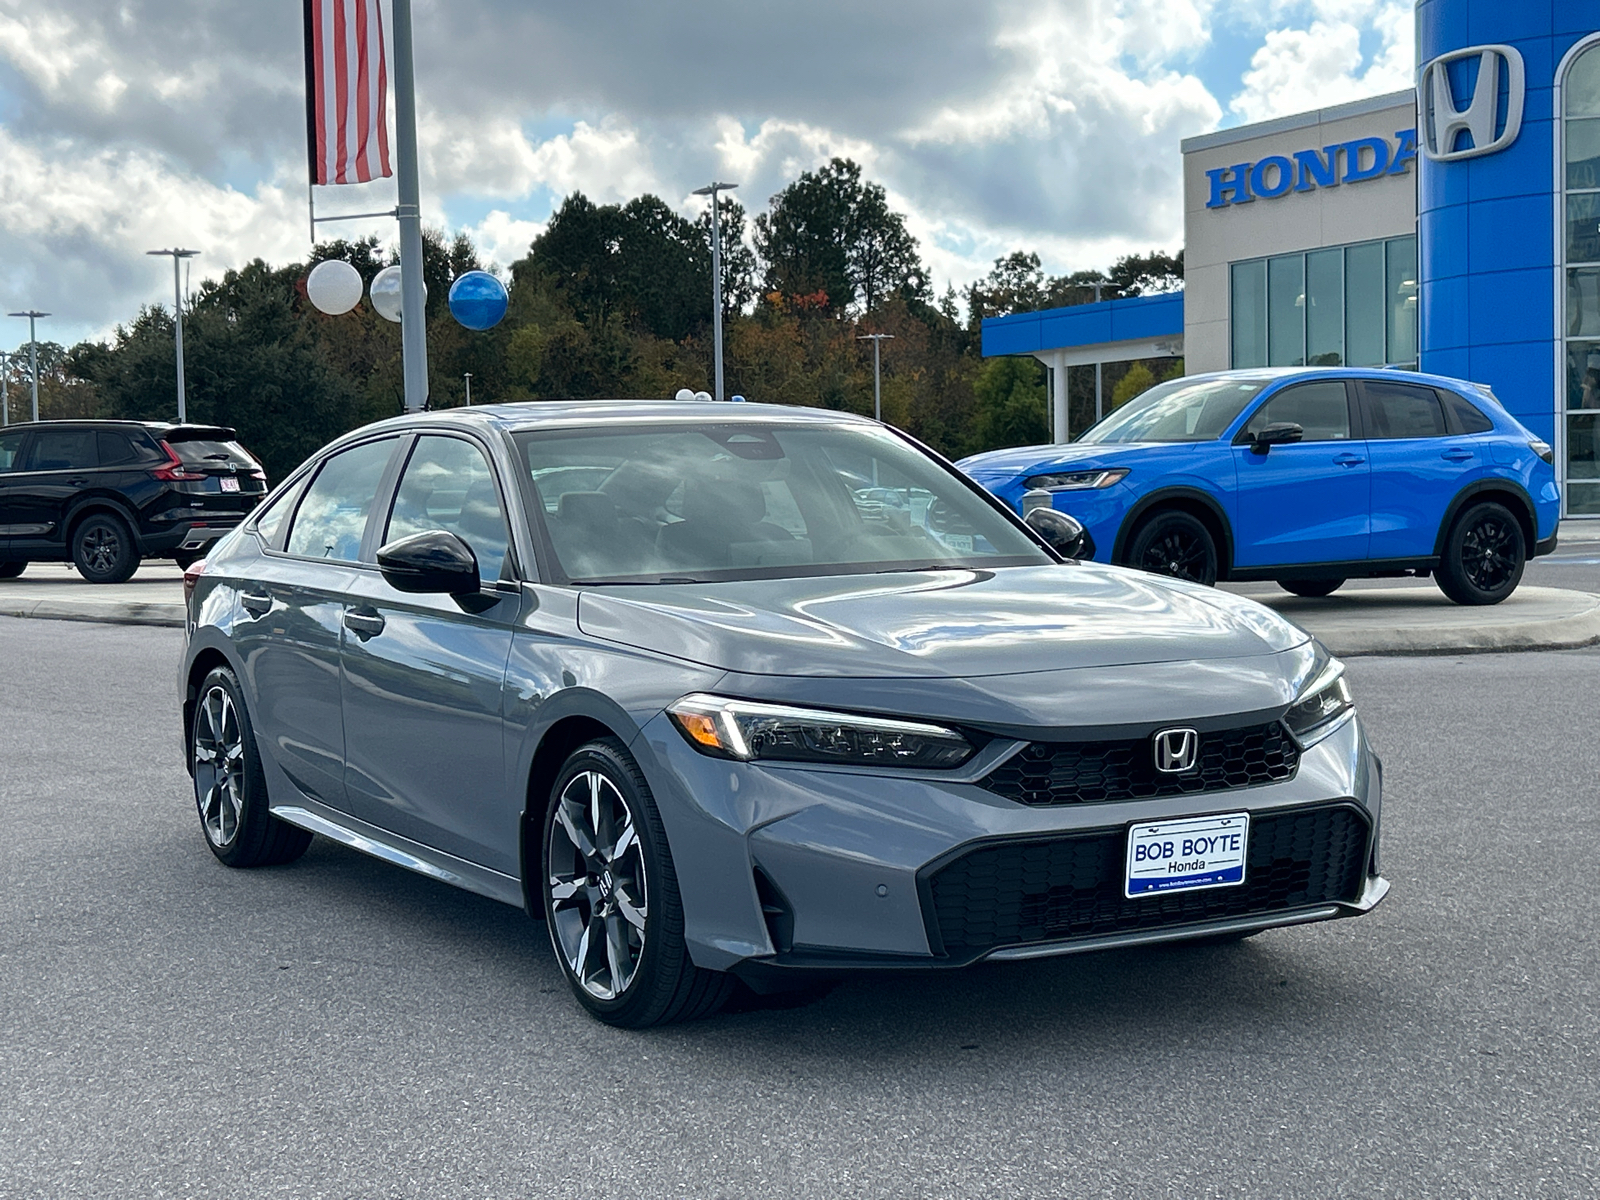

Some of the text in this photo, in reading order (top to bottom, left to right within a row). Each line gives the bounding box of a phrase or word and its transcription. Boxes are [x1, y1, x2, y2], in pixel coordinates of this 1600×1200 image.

[1205, 128, 1415, 208] HONDA
[1135, 833, 1241, 862] BOB BOYTE
[1168, 859, 1206, 873] Honda
